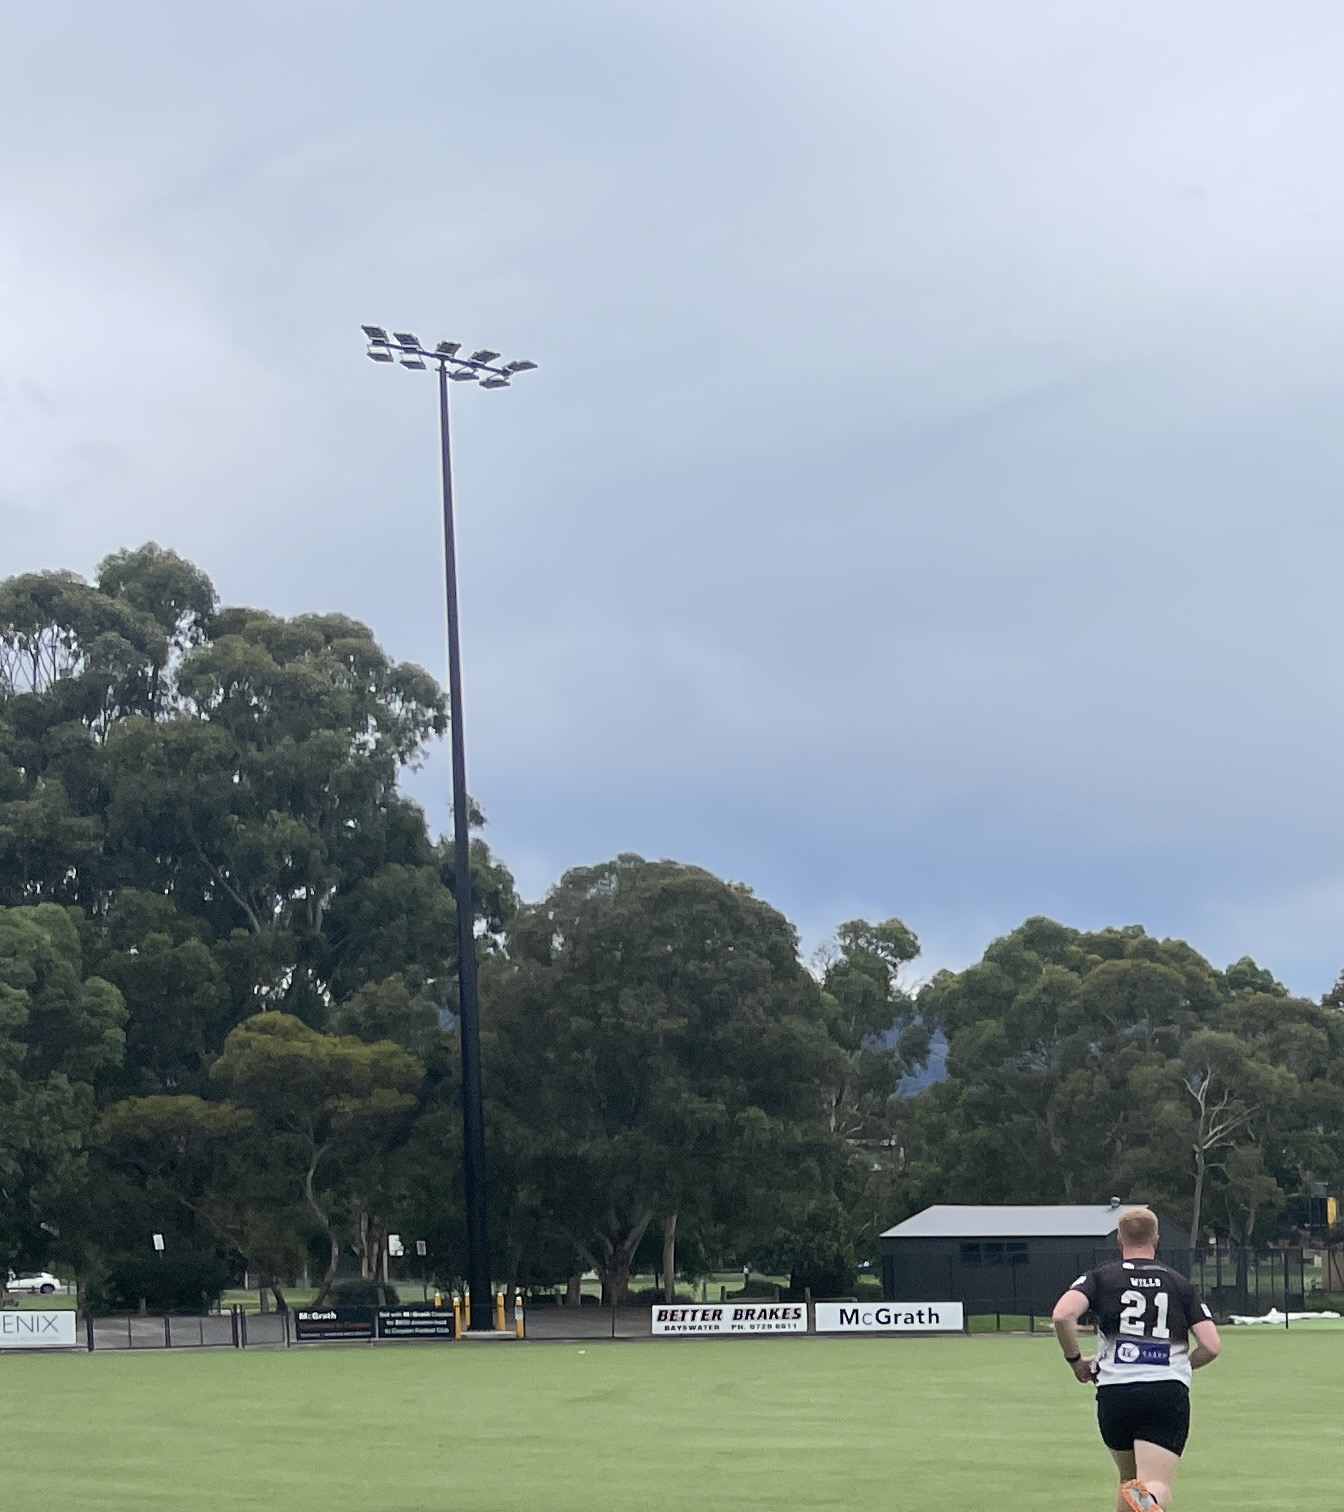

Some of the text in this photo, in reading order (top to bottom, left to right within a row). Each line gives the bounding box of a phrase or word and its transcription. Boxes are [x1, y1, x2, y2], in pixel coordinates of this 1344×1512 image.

[656, 1307, 802, 1322] BETTER BRAKES
[839, 1307, 940, 1326] McGrath
[1119, 1290, 1170, 1339] 21
